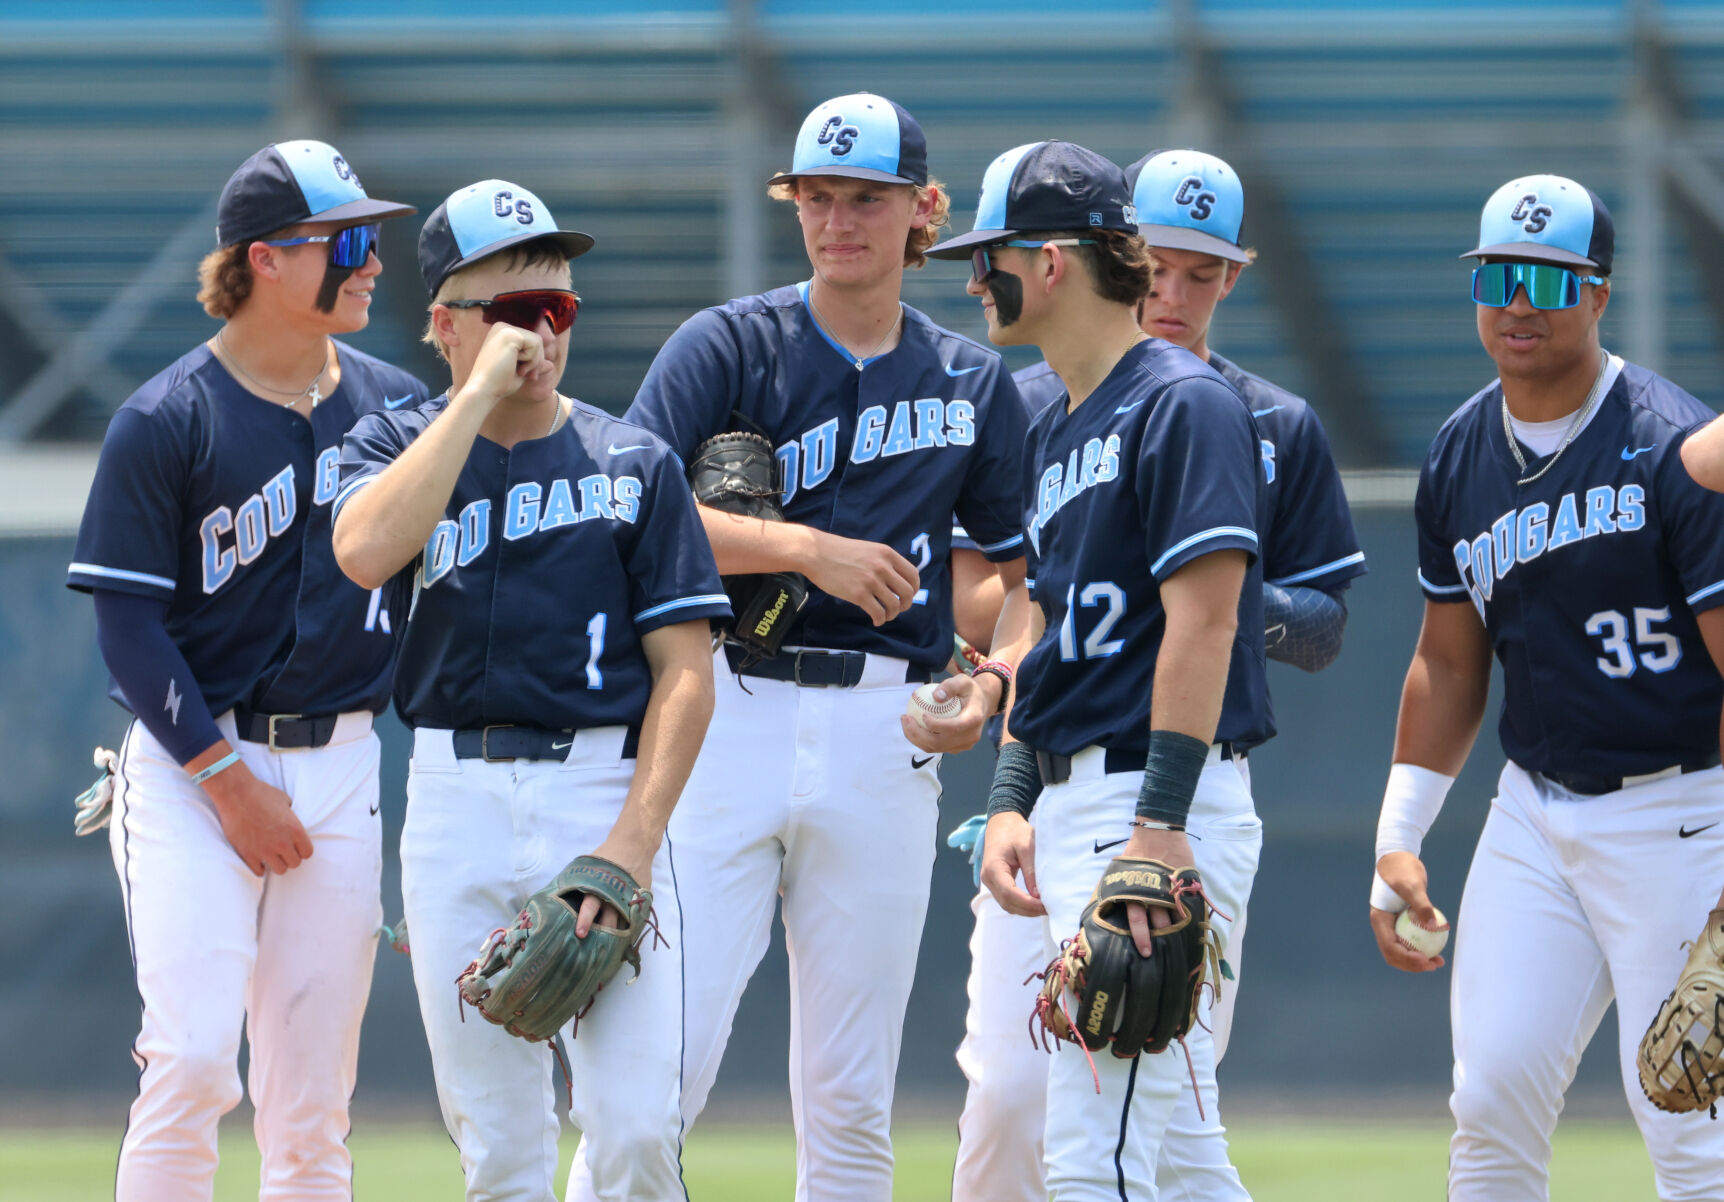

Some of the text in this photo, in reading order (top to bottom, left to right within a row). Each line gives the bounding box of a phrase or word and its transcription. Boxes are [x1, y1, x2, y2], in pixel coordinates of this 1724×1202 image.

[817, 115, 859, 156] CS
[494, 190, 534, 225] CS
[1175, 178, 1216, 221] CS
[1511, 194, 1552, 234] CS
[1453, 484, 1646, 628] COUGARS
[754, 589, 789, 637] Wilson
[1059, 581, 1127, 662] 12
[586, 612, 607, 690] 1
[1585, 606, 1683, 679] 35
[1104, 869, 1162, 890] Wilson
[1086, 990, 1109, 1036] A2000
